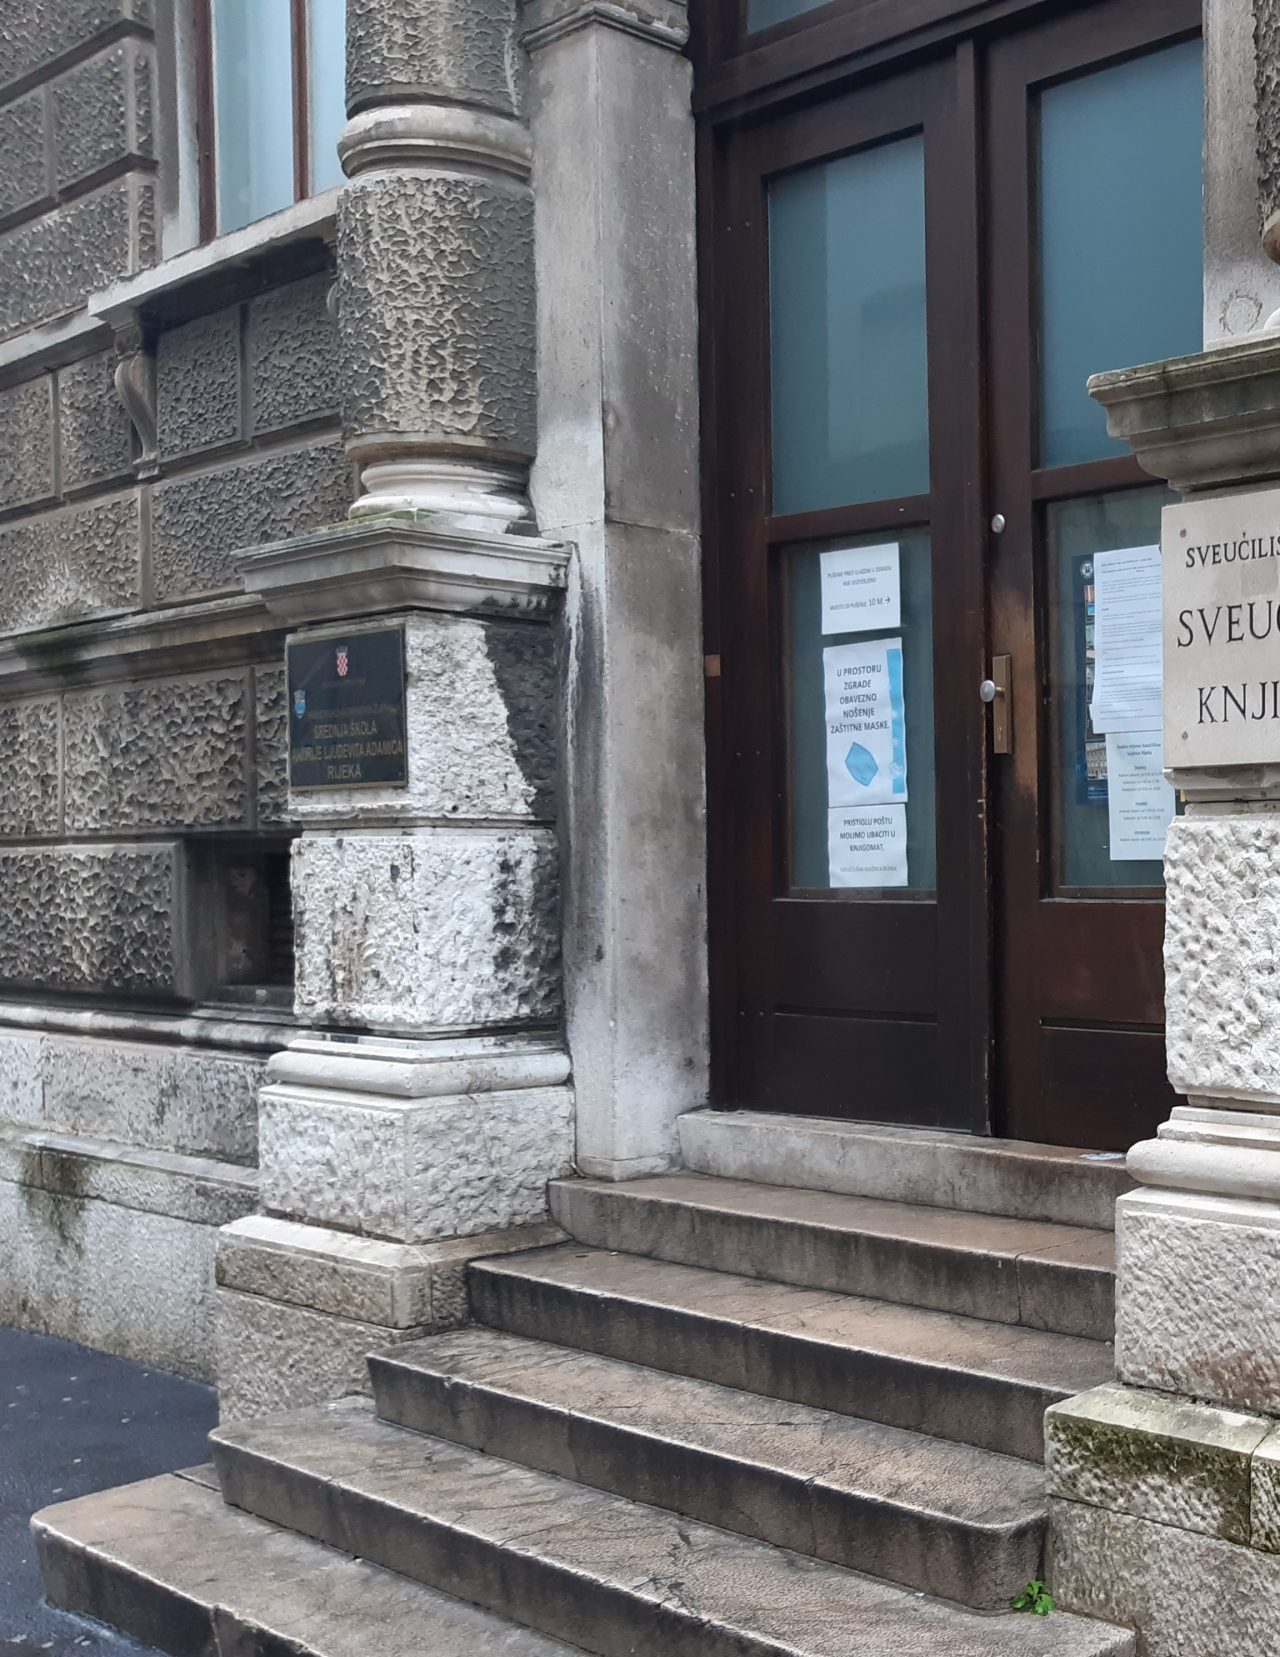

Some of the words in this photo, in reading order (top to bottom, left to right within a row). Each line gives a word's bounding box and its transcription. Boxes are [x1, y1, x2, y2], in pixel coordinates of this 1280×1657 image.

[869, 597, 876, 606] 10
[837, 669, 842, 677] U
[843, 664, 882, 677] PROSTORU
[844, 679, 872, 690] ZGRADE
[839, 693, 877, 705] OBAVEZNO
[843, 706, 875, 719] NOŠENJE
[830, 722, 862, 734] ZAŠTITNE
[327, 764, 361, 779] RIJEKA
[843, 817, 872, 827] PRISTIGLU
[873, 815, 893, 825] POŠTU
[840, 831, 865, 840] MOLIMO
[866, 830, 889, 839] UBACITI
[890, 830, 896, 838] U
